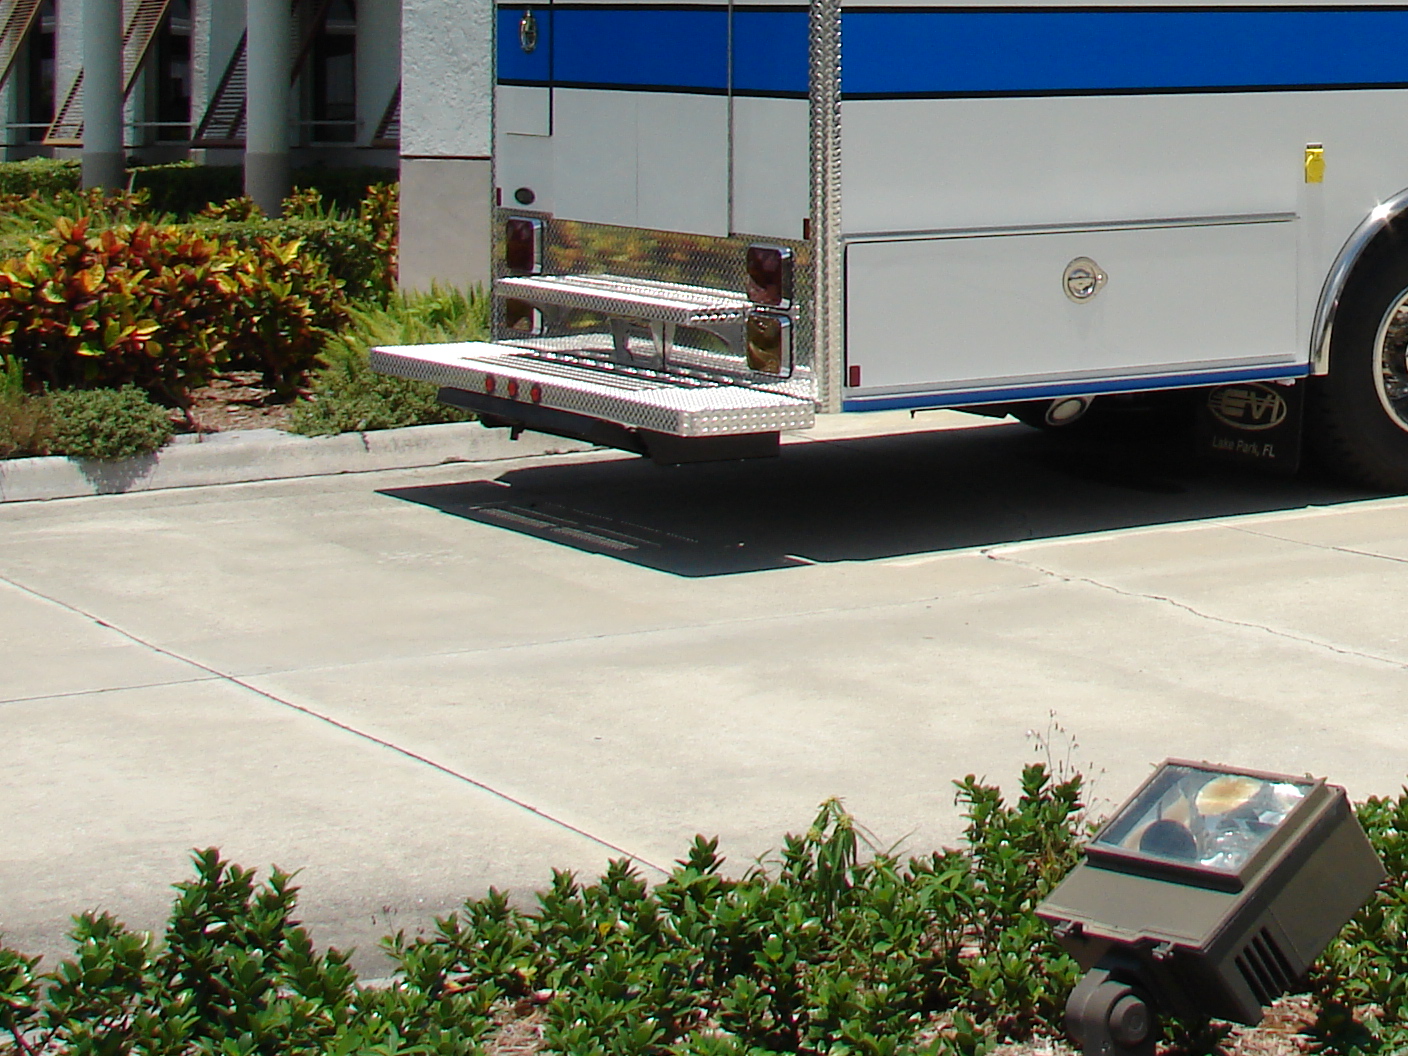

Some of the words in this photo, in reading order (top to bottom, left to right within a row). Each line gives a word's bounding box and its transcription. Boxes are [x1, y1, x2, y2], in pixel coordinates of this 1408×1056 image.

[1219, 388, 1281, 424] EVI
[1212, 435, 1235, 450] Lake
[1262, 443, 1276, 458] FL
